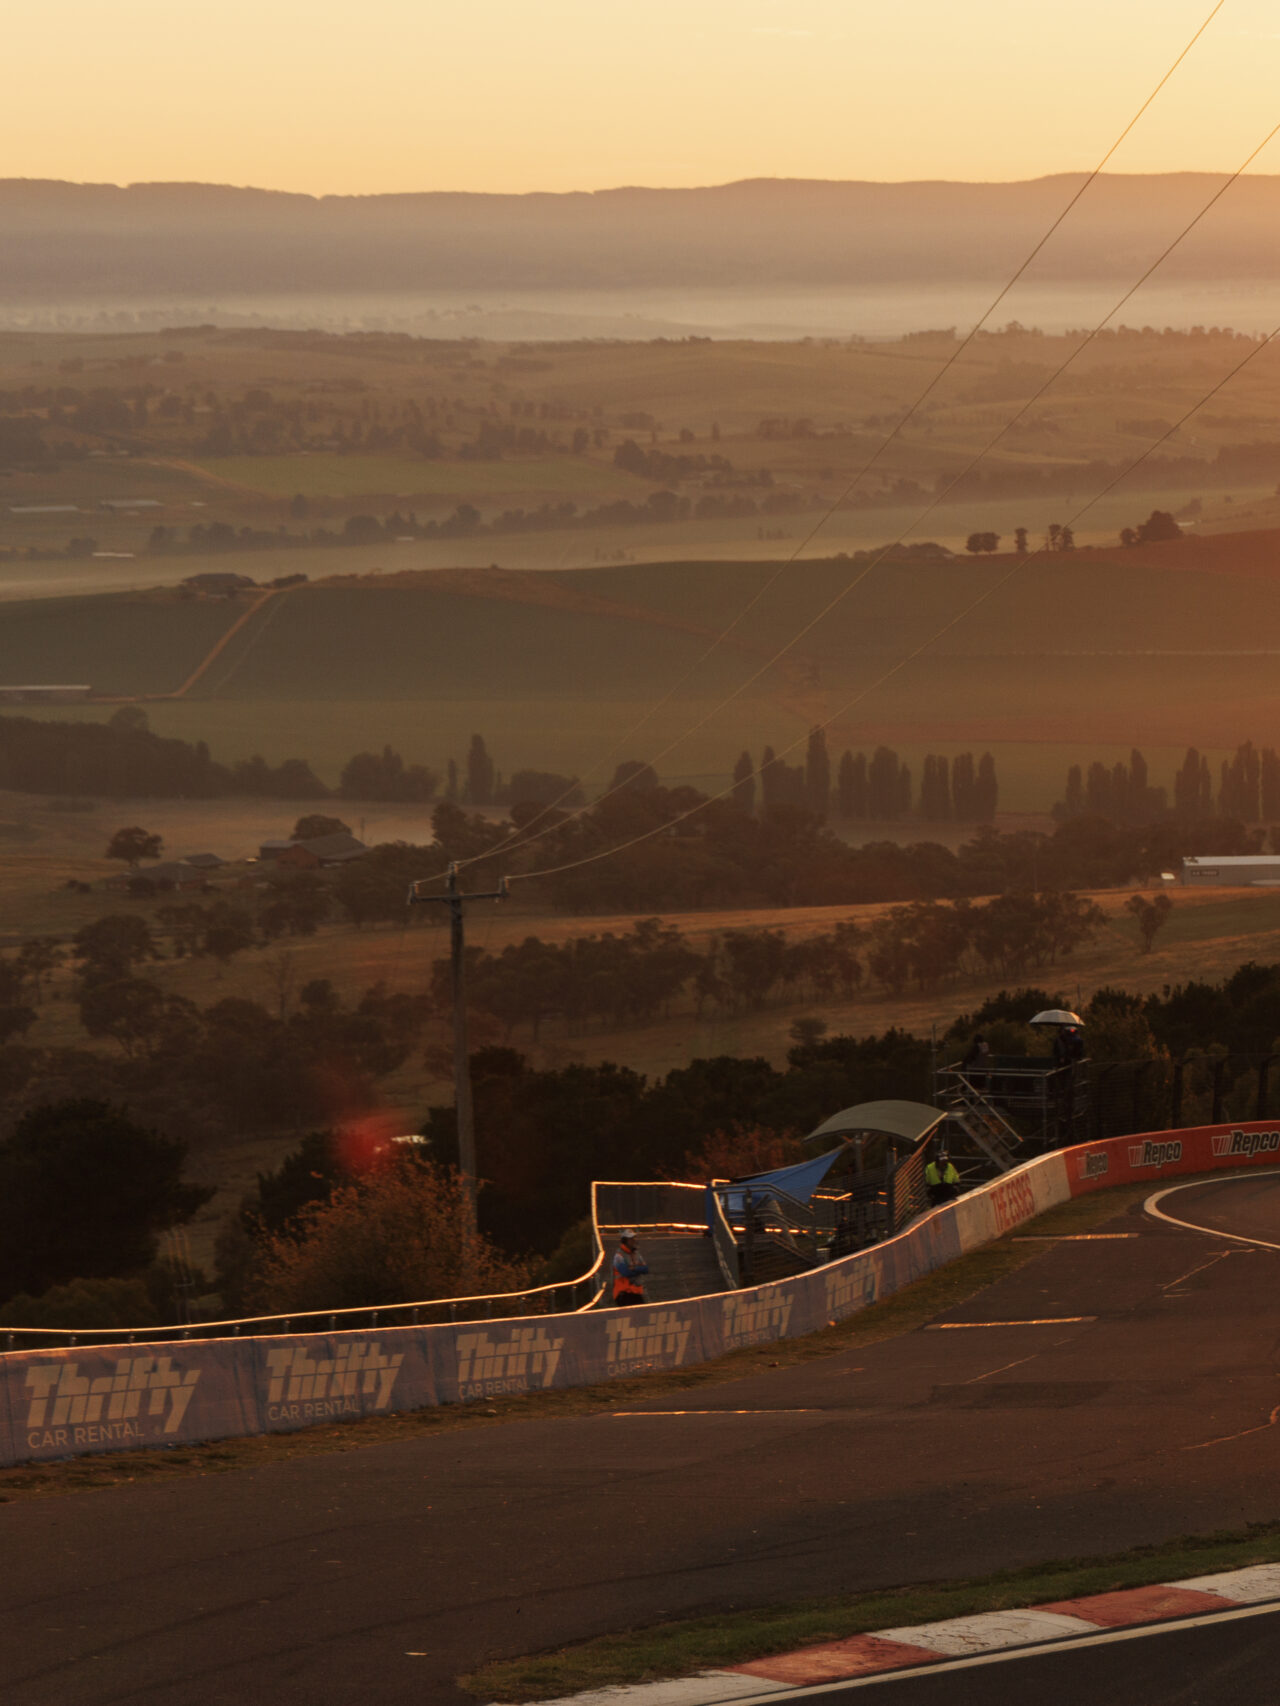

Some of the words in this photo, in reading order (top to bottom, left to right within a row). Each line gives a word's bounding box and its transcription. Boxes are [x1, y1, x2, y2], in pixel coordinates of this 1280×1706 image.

[1143, 1141, 1182, 1168] Repco
[1230, 1131, 1280, 1157] Repco
[990, 1186, 1010, 1231] THE
[1010, 1173, 1036, 1225] ESSES
[723, 1287, 794, 1337] Thrifty
[456, 1328, 565, 1388] Thrifty
[605, 1312, 691, 1365] Thrifty
[266, 1342, 405, 1409] Thrifty
[459, 1383, 483, 1400] CAR
[486, 1378, 530, 1397] RENTAL
[608, 1362, 627, 1377] CAR
[25, 1357, 201, 1433] Thrifty
[268, 1404, 300, 1421] CAR
[305, 1396, 360, 1418] RENTAL
[28, 1431, 68, 1449] CAR
[75, 1421, 145, 1444] RENTAL
